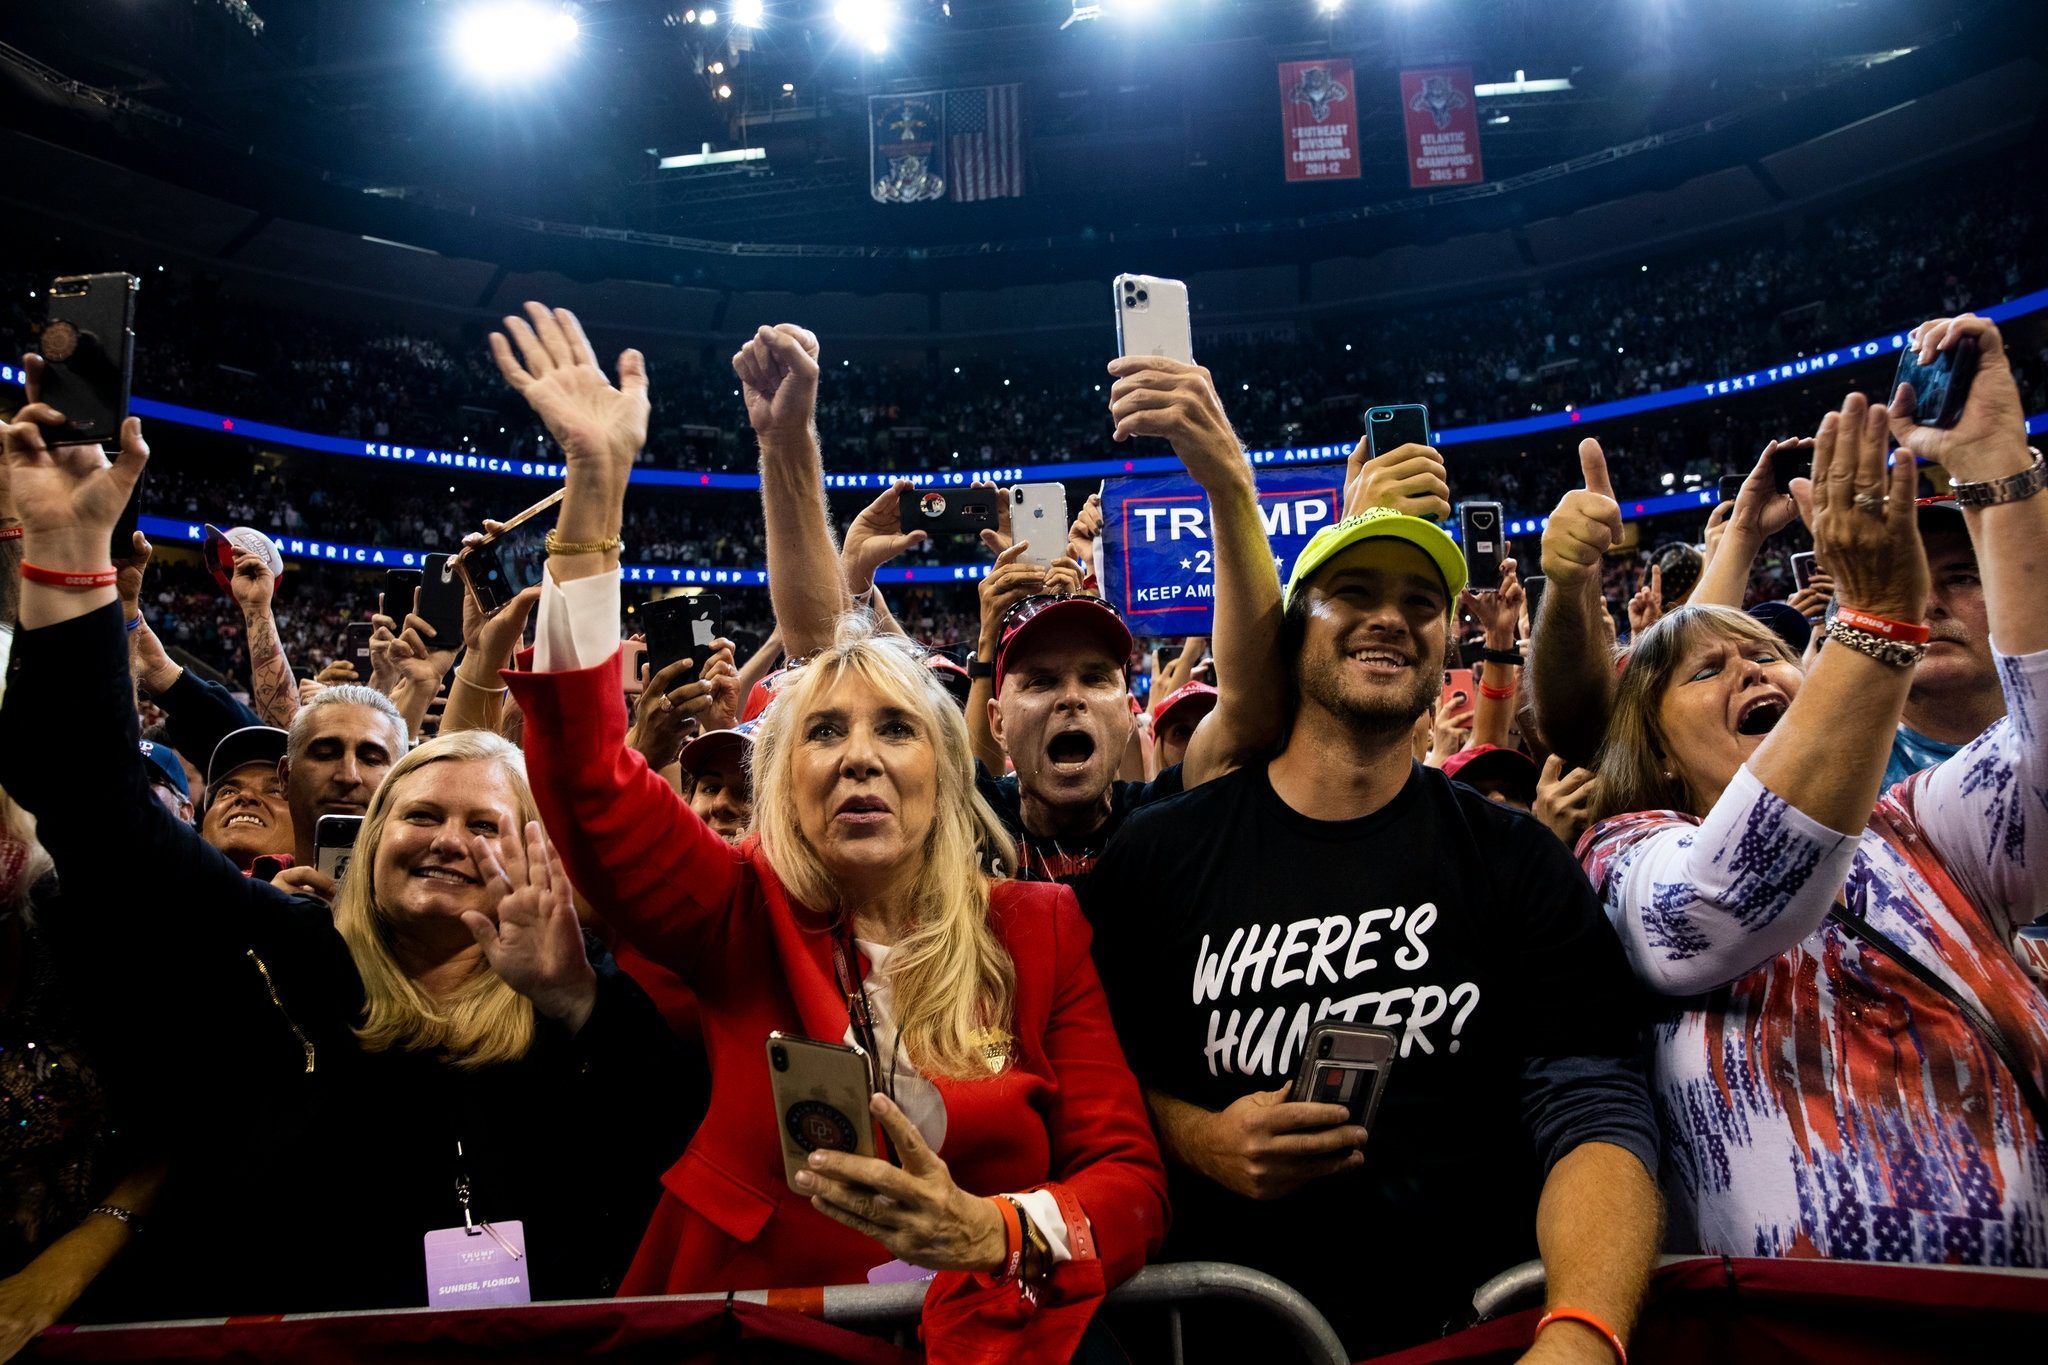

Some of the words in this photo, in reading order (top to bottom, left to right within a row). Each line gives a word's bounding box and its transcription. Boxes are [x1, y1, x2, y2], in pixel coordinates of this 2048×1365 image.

[1292, 125, 1348, 138] SOUTHEAST
[1421, 132, 1465, 144] ATLANTIC
[1299, 137, 1343, 149] DIVISION
[1422, 143, 1465, 156] DIVISION
[1292, 147, 1351, 162] CHAMPIONS
[1416, 153, 1473, 169] CHAMPIONS
[1305, 161, 1340, 175] 2011-12
[1429, 166, 1467, 181] 2015-16
[1705, 374, 1757, 396] TEXT
[1768, 352, 1839, 381] TRUMP
[1850, 341, 1879, 359] TO
[365, 443, 415, 459] KEEP
[426, 451, 512, 473] AMERICA
[521, 463, 569, 477] GREA
[1284, 443, 1354, 461] AMERIC
[825, 475, 868, 487] TEXT
[943, 472, 964, 485] TO
[972, 469, 1023, 483] 88022
[1133, 498, 1328, 542] TRMP
[275, 537, 386, 564] AMERICA
[671, 570, 742, 583] TRUMP
[954, 565, 992, 579] KEE
[1136, 585, 1181, 602] KEEP
[1856, 615, 1893, 633] Pence
[1193, 902, 1438, 1005] WHERE'S
[461, 1249, 495, 1261] TRUMP
[439, 1282, 480, 1295] SUNRISE,
[482, 1276, 521, 1288] FLORIDA
